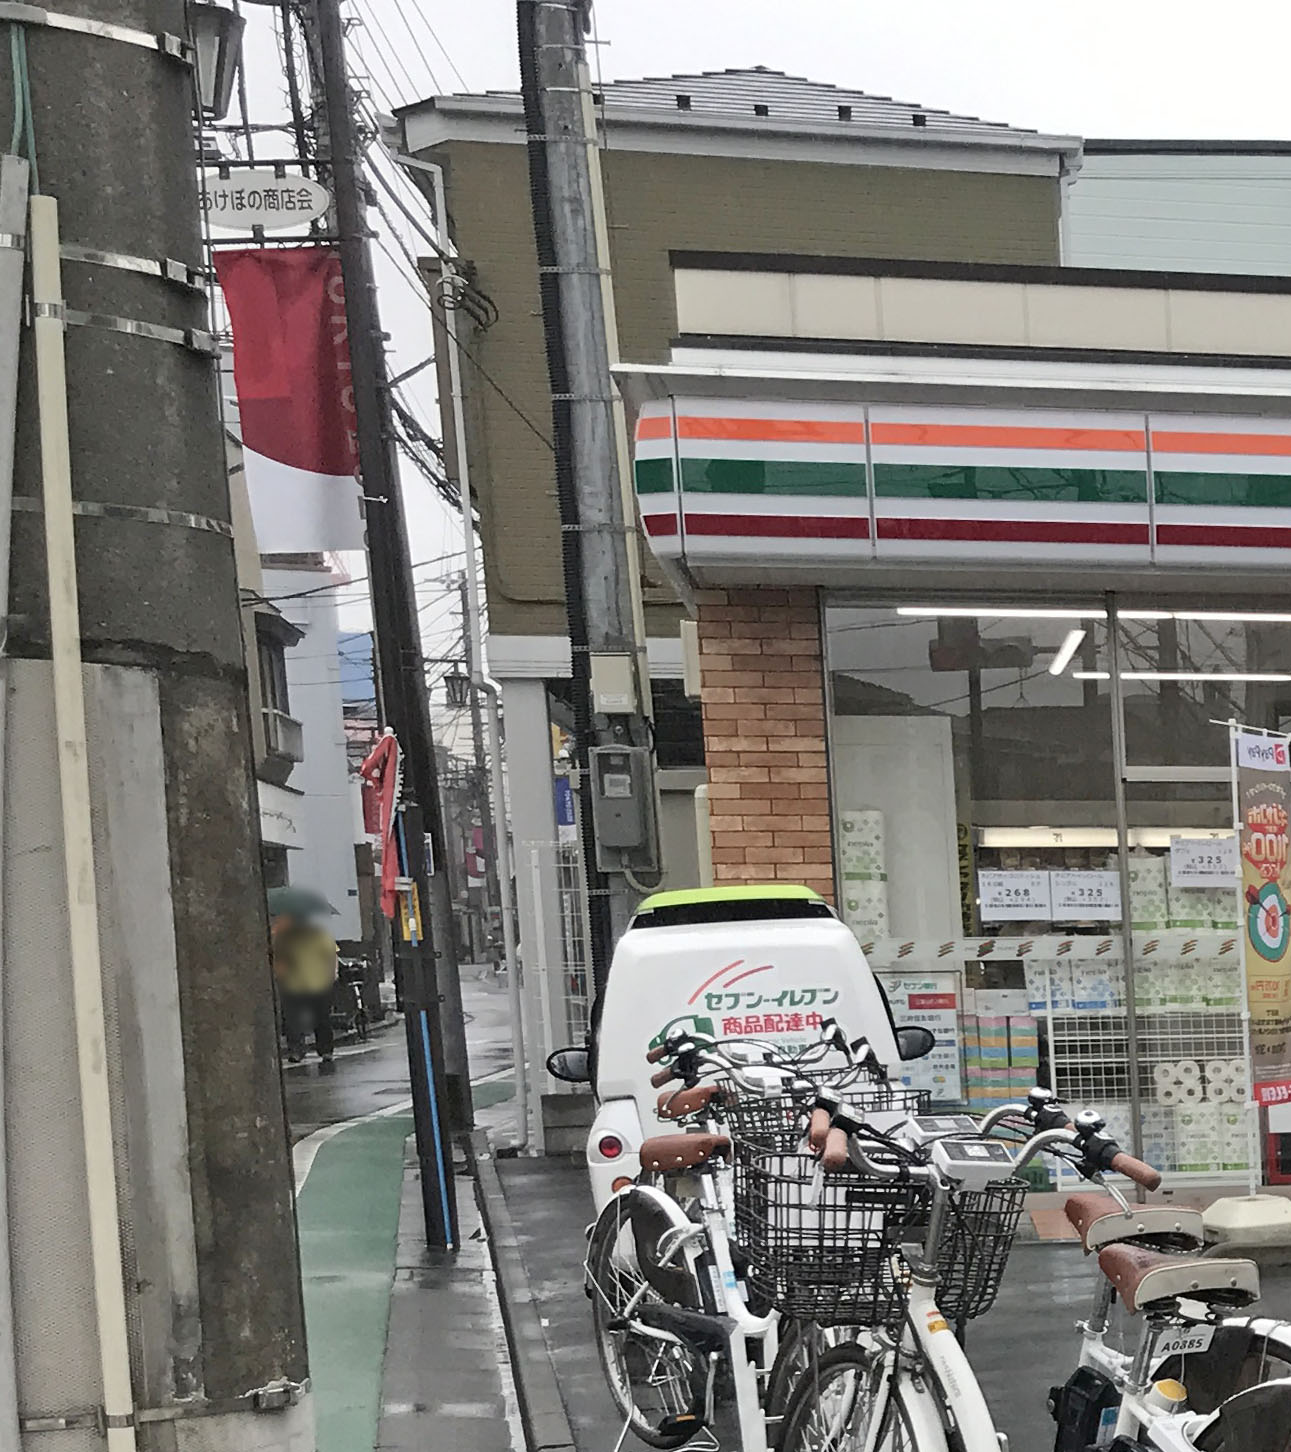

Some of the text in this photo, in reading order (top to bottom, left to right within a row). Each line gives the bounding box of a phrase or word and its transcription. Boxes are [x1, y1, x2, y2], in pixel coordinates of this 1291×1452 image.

[722, 1011, 824, 1036] 商品配達中
